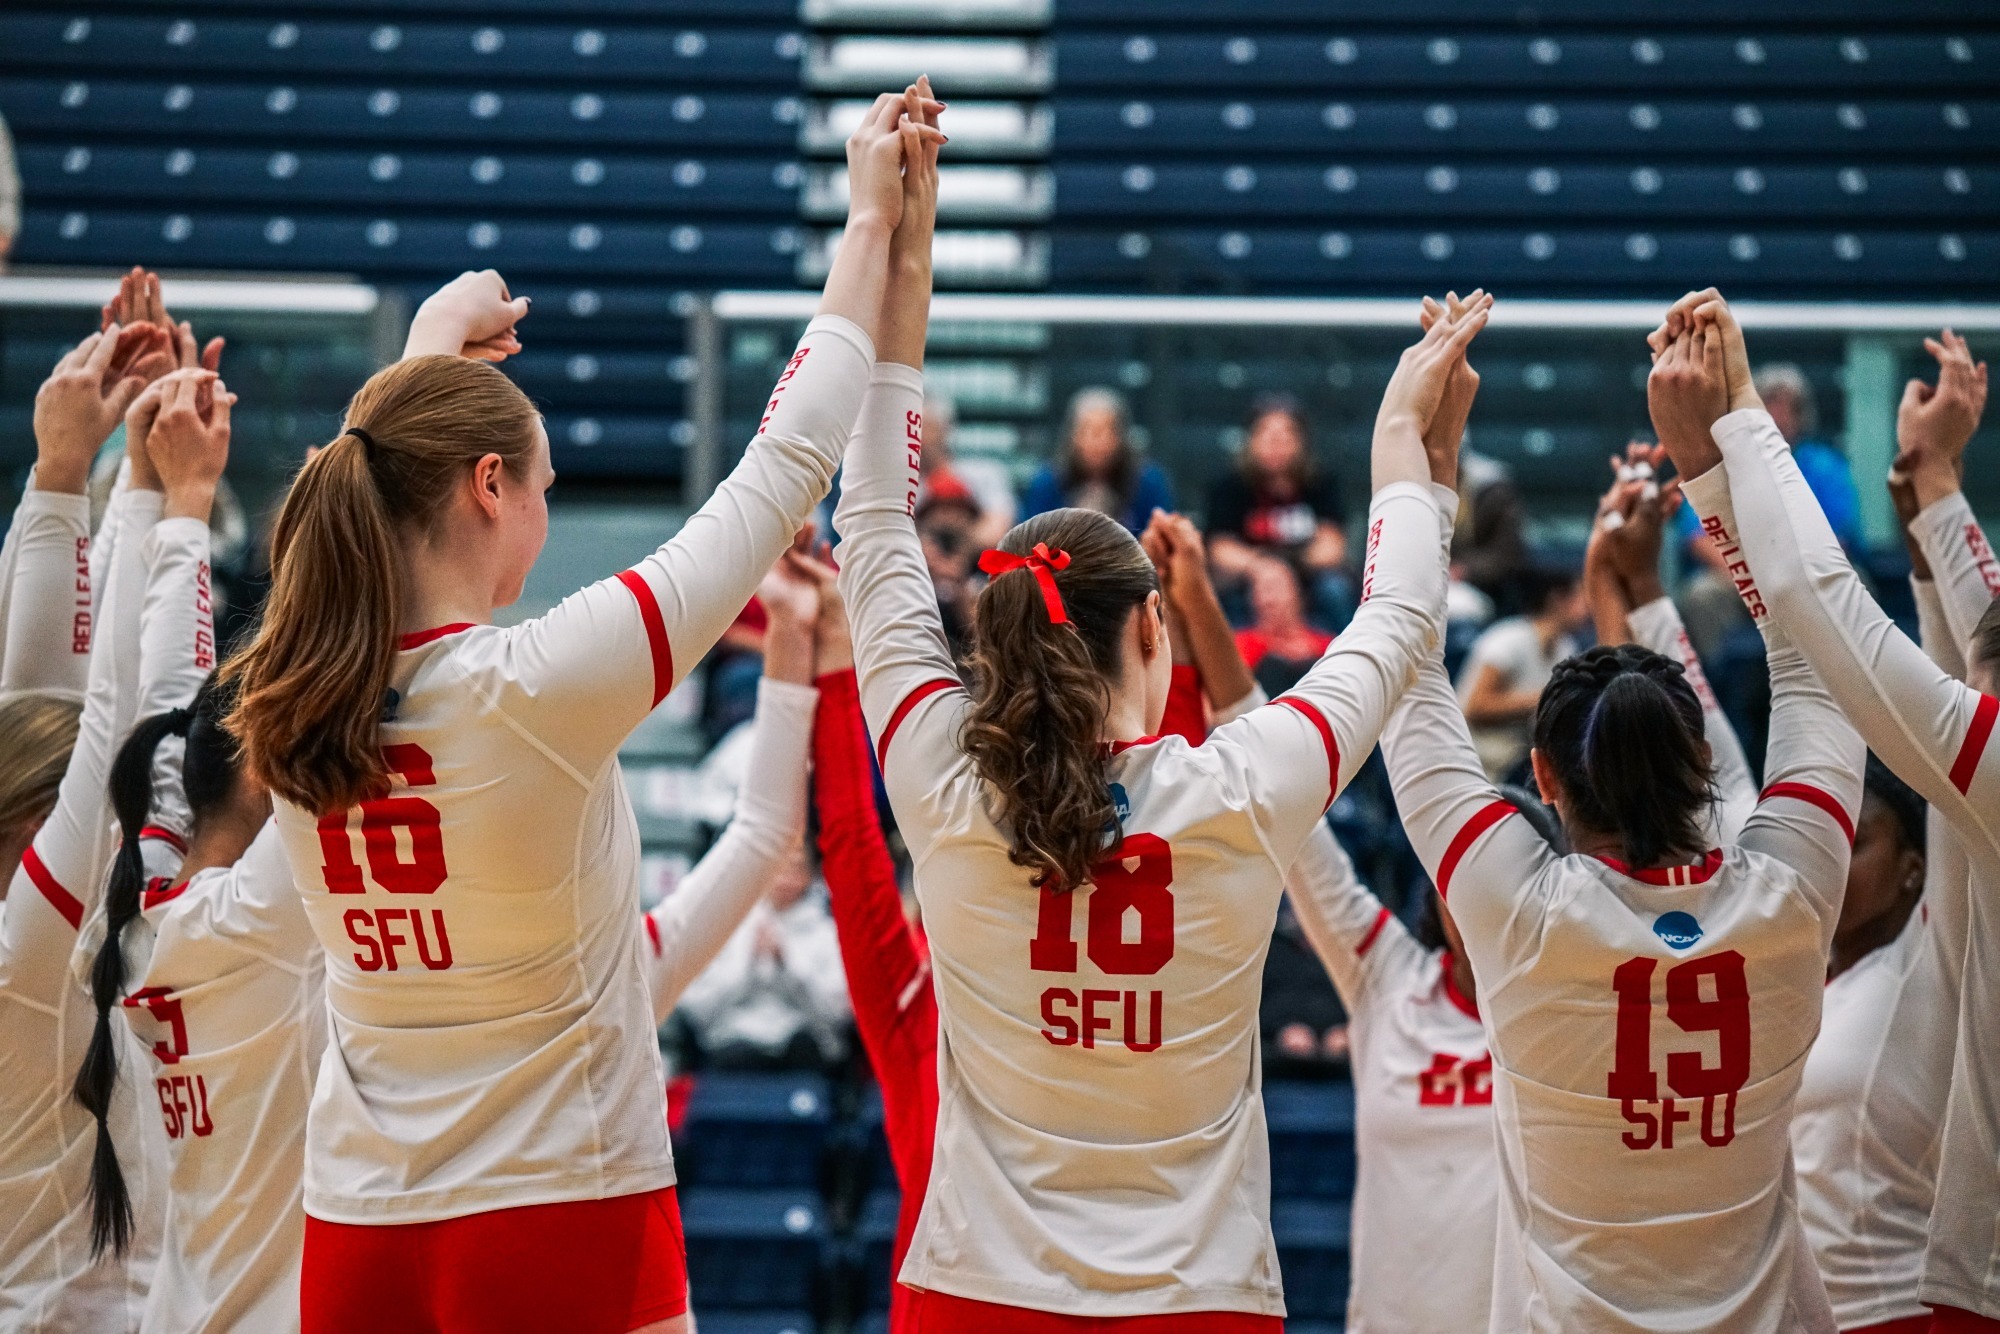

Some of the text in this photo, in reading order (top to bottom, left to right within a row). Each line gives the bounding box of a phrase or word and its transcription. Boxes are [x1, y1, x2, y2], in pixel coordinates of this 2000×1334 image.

[906, 410, 922, 488] LEAFS
[72, 536, 92, 655] RED LEAFS
[194, 560, 214, 671] RED LEAFS
[1721, 546, 1767, 619] LEAFS
[316, 742, 448, 894] 16
[343, 908, 454, 972] SFU
[1030, 832, 1175, 976] 18
[1659, 932, 1702, 945] NCAA
[1040, 987, 1163, 1053] SFU
[1607, 949, 1751, 1101] 19
[156, 1074, 215, 1139] SFU
[1620, 1091, 1736, 1151] SFU
